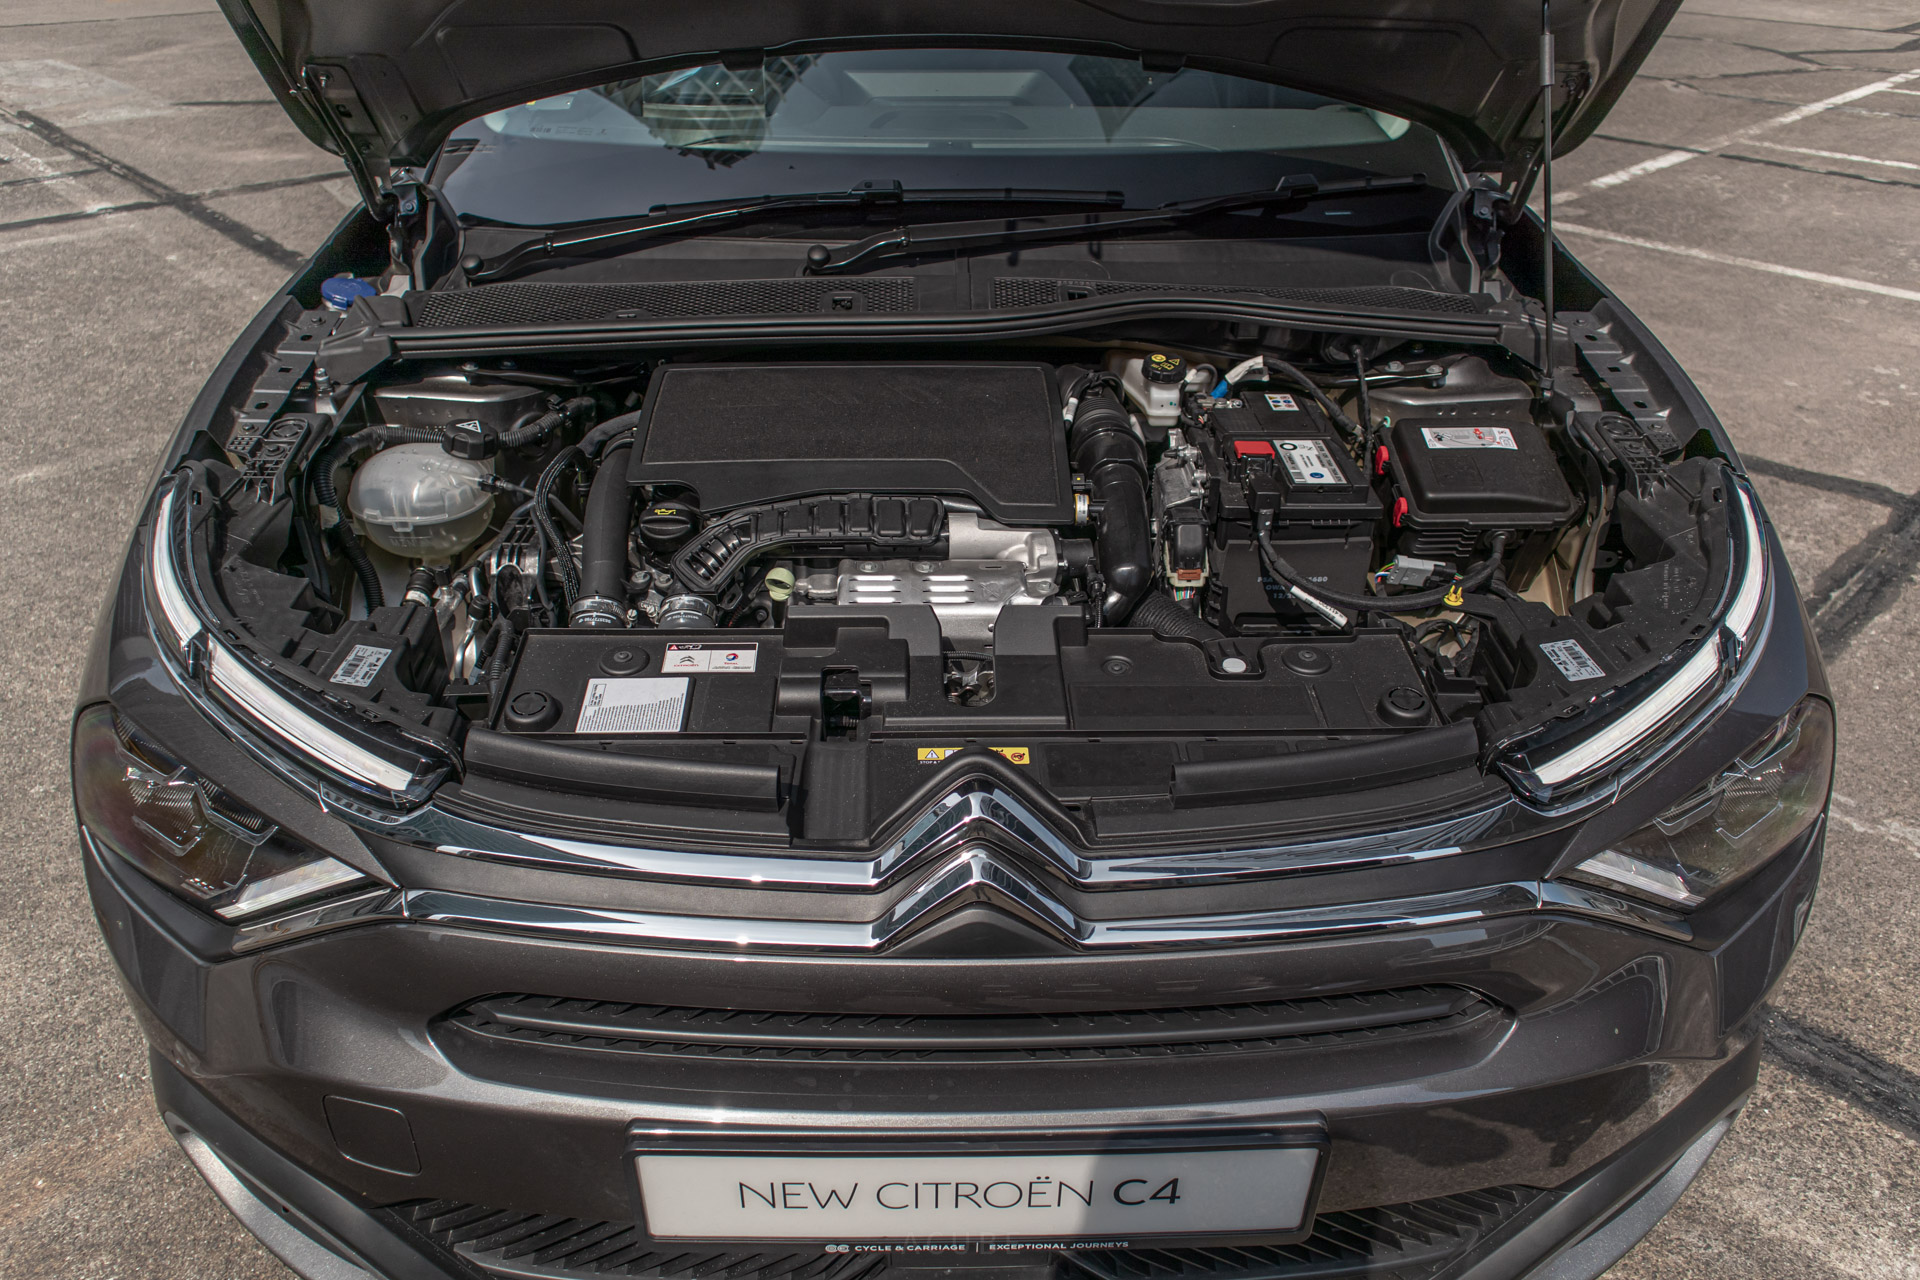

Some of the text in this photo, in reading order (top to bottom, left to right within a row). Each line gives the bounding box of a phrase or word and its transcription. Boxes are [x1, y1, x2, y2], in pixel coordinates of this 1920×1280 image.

[739, 1176, 1181, 1210] NEW CITROËN C4
[854, 1244, 892, 1252] CYCLE
[894, 1244, 904, 1252] &
[906, 1244, 966, 1252] CARRIAGE
[988, 1243, 1067, 1251] EXCEPTIONAL
[1069, 1241, 1129, 1250] JOURNEYS
